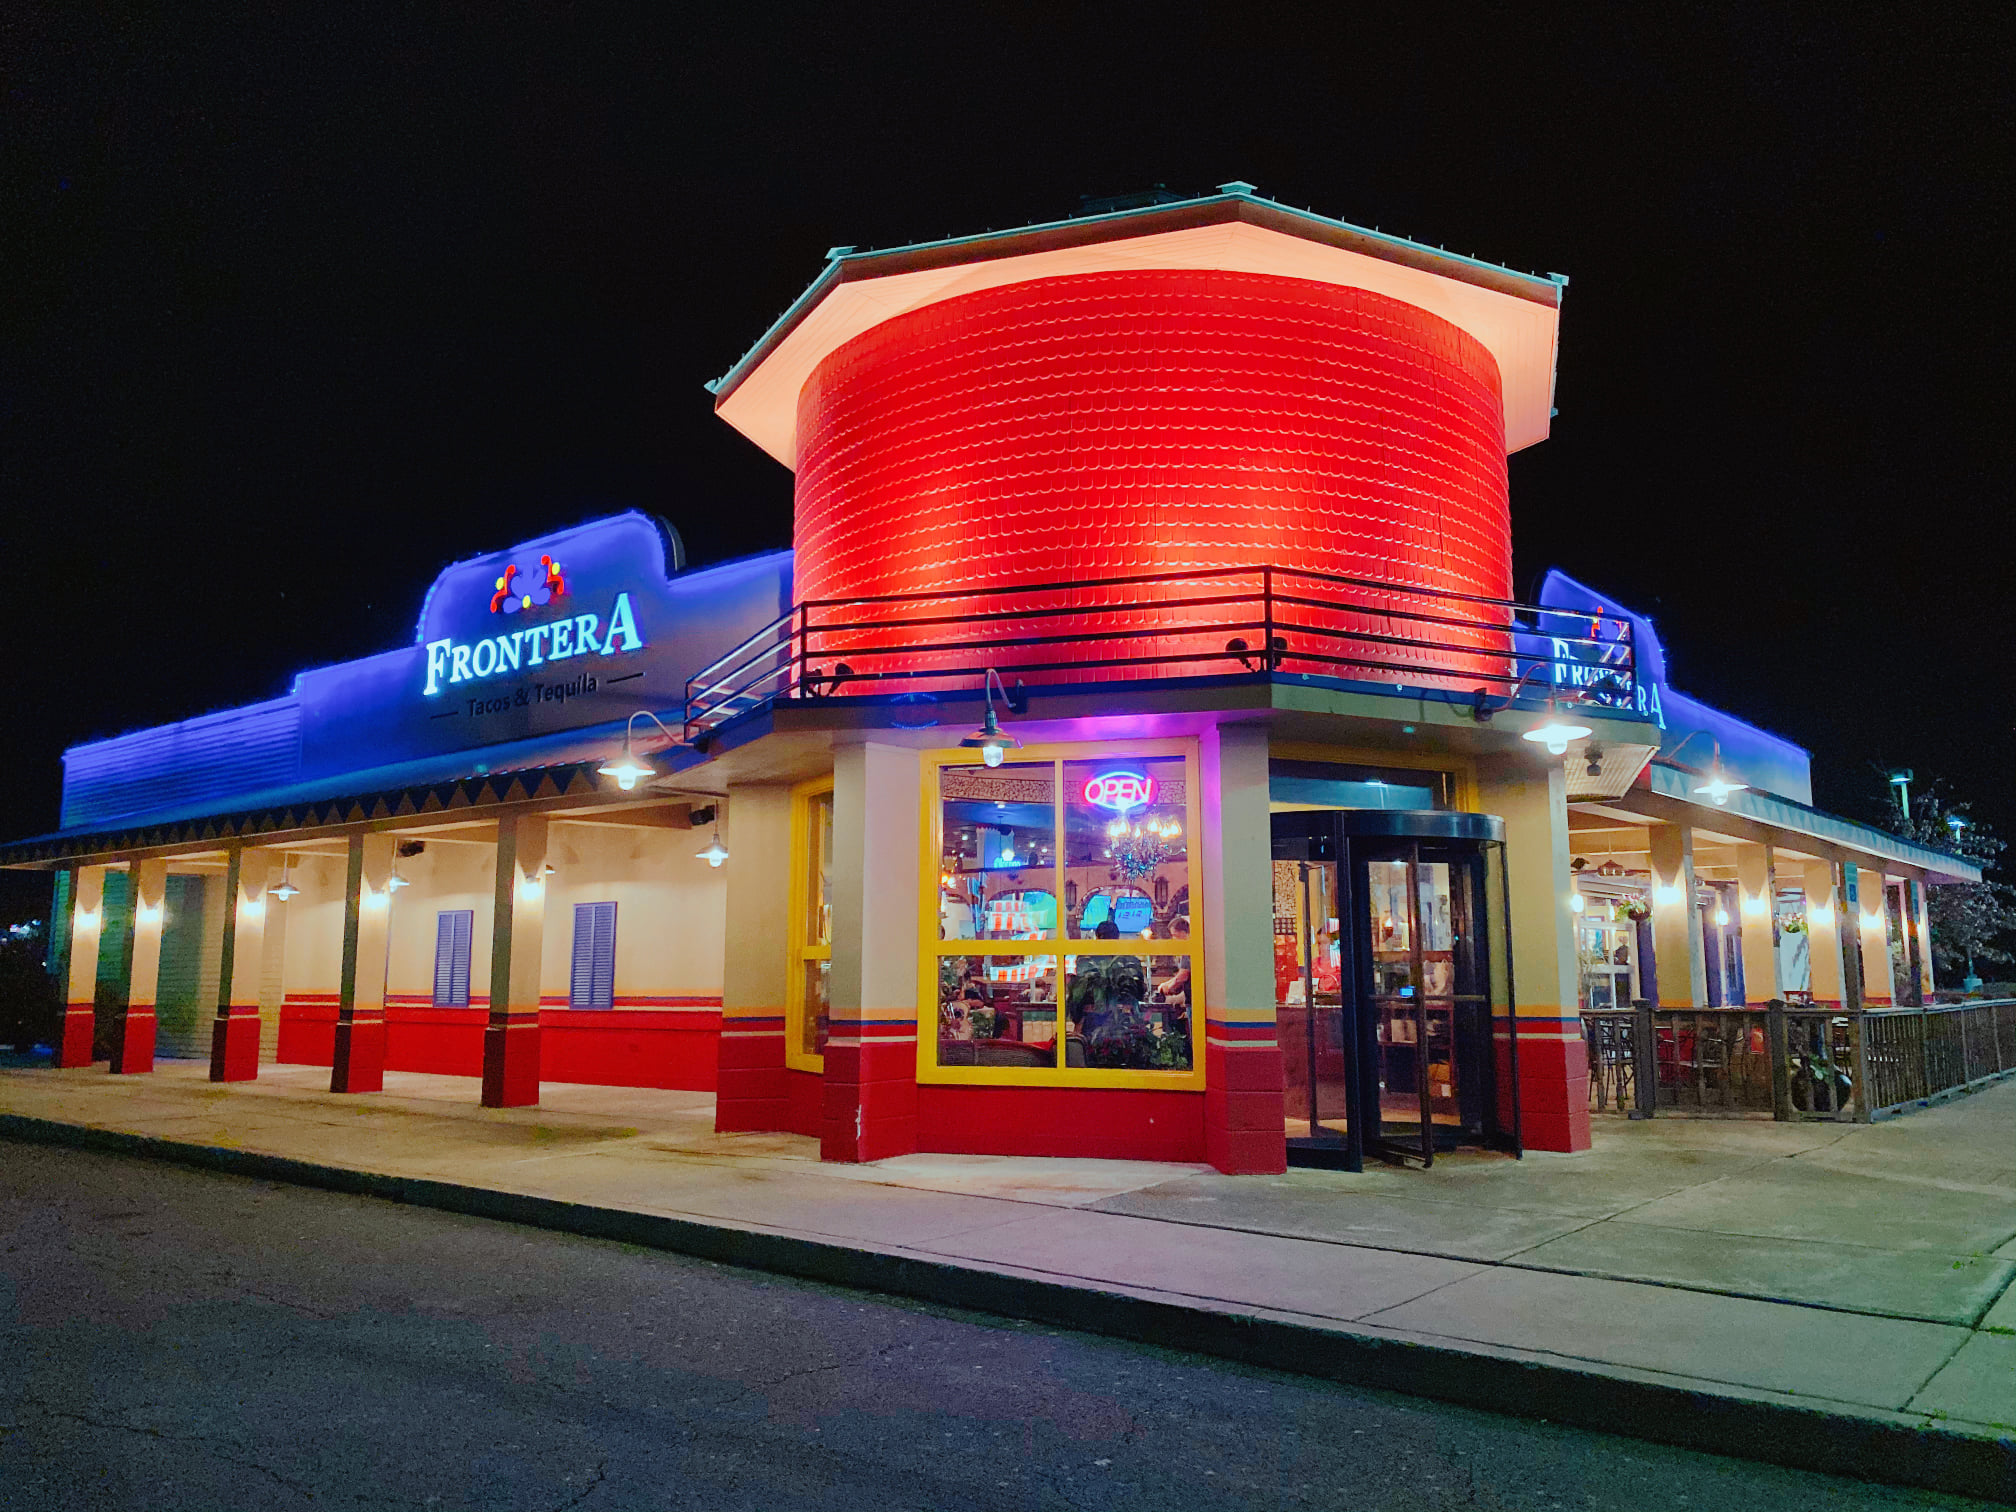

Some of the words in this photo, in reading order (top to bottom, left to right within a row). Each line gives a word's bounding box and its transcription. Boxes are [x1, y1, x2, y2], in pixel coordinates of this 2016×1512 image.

[423, 593, 643, 696] FRONTERA
[467, 696, 511, 717] Tacos
[514, 687, 530, 706] &
[535, 671, 600, 704] Tequila
[1085, 779, 1152, 803] OPEN
